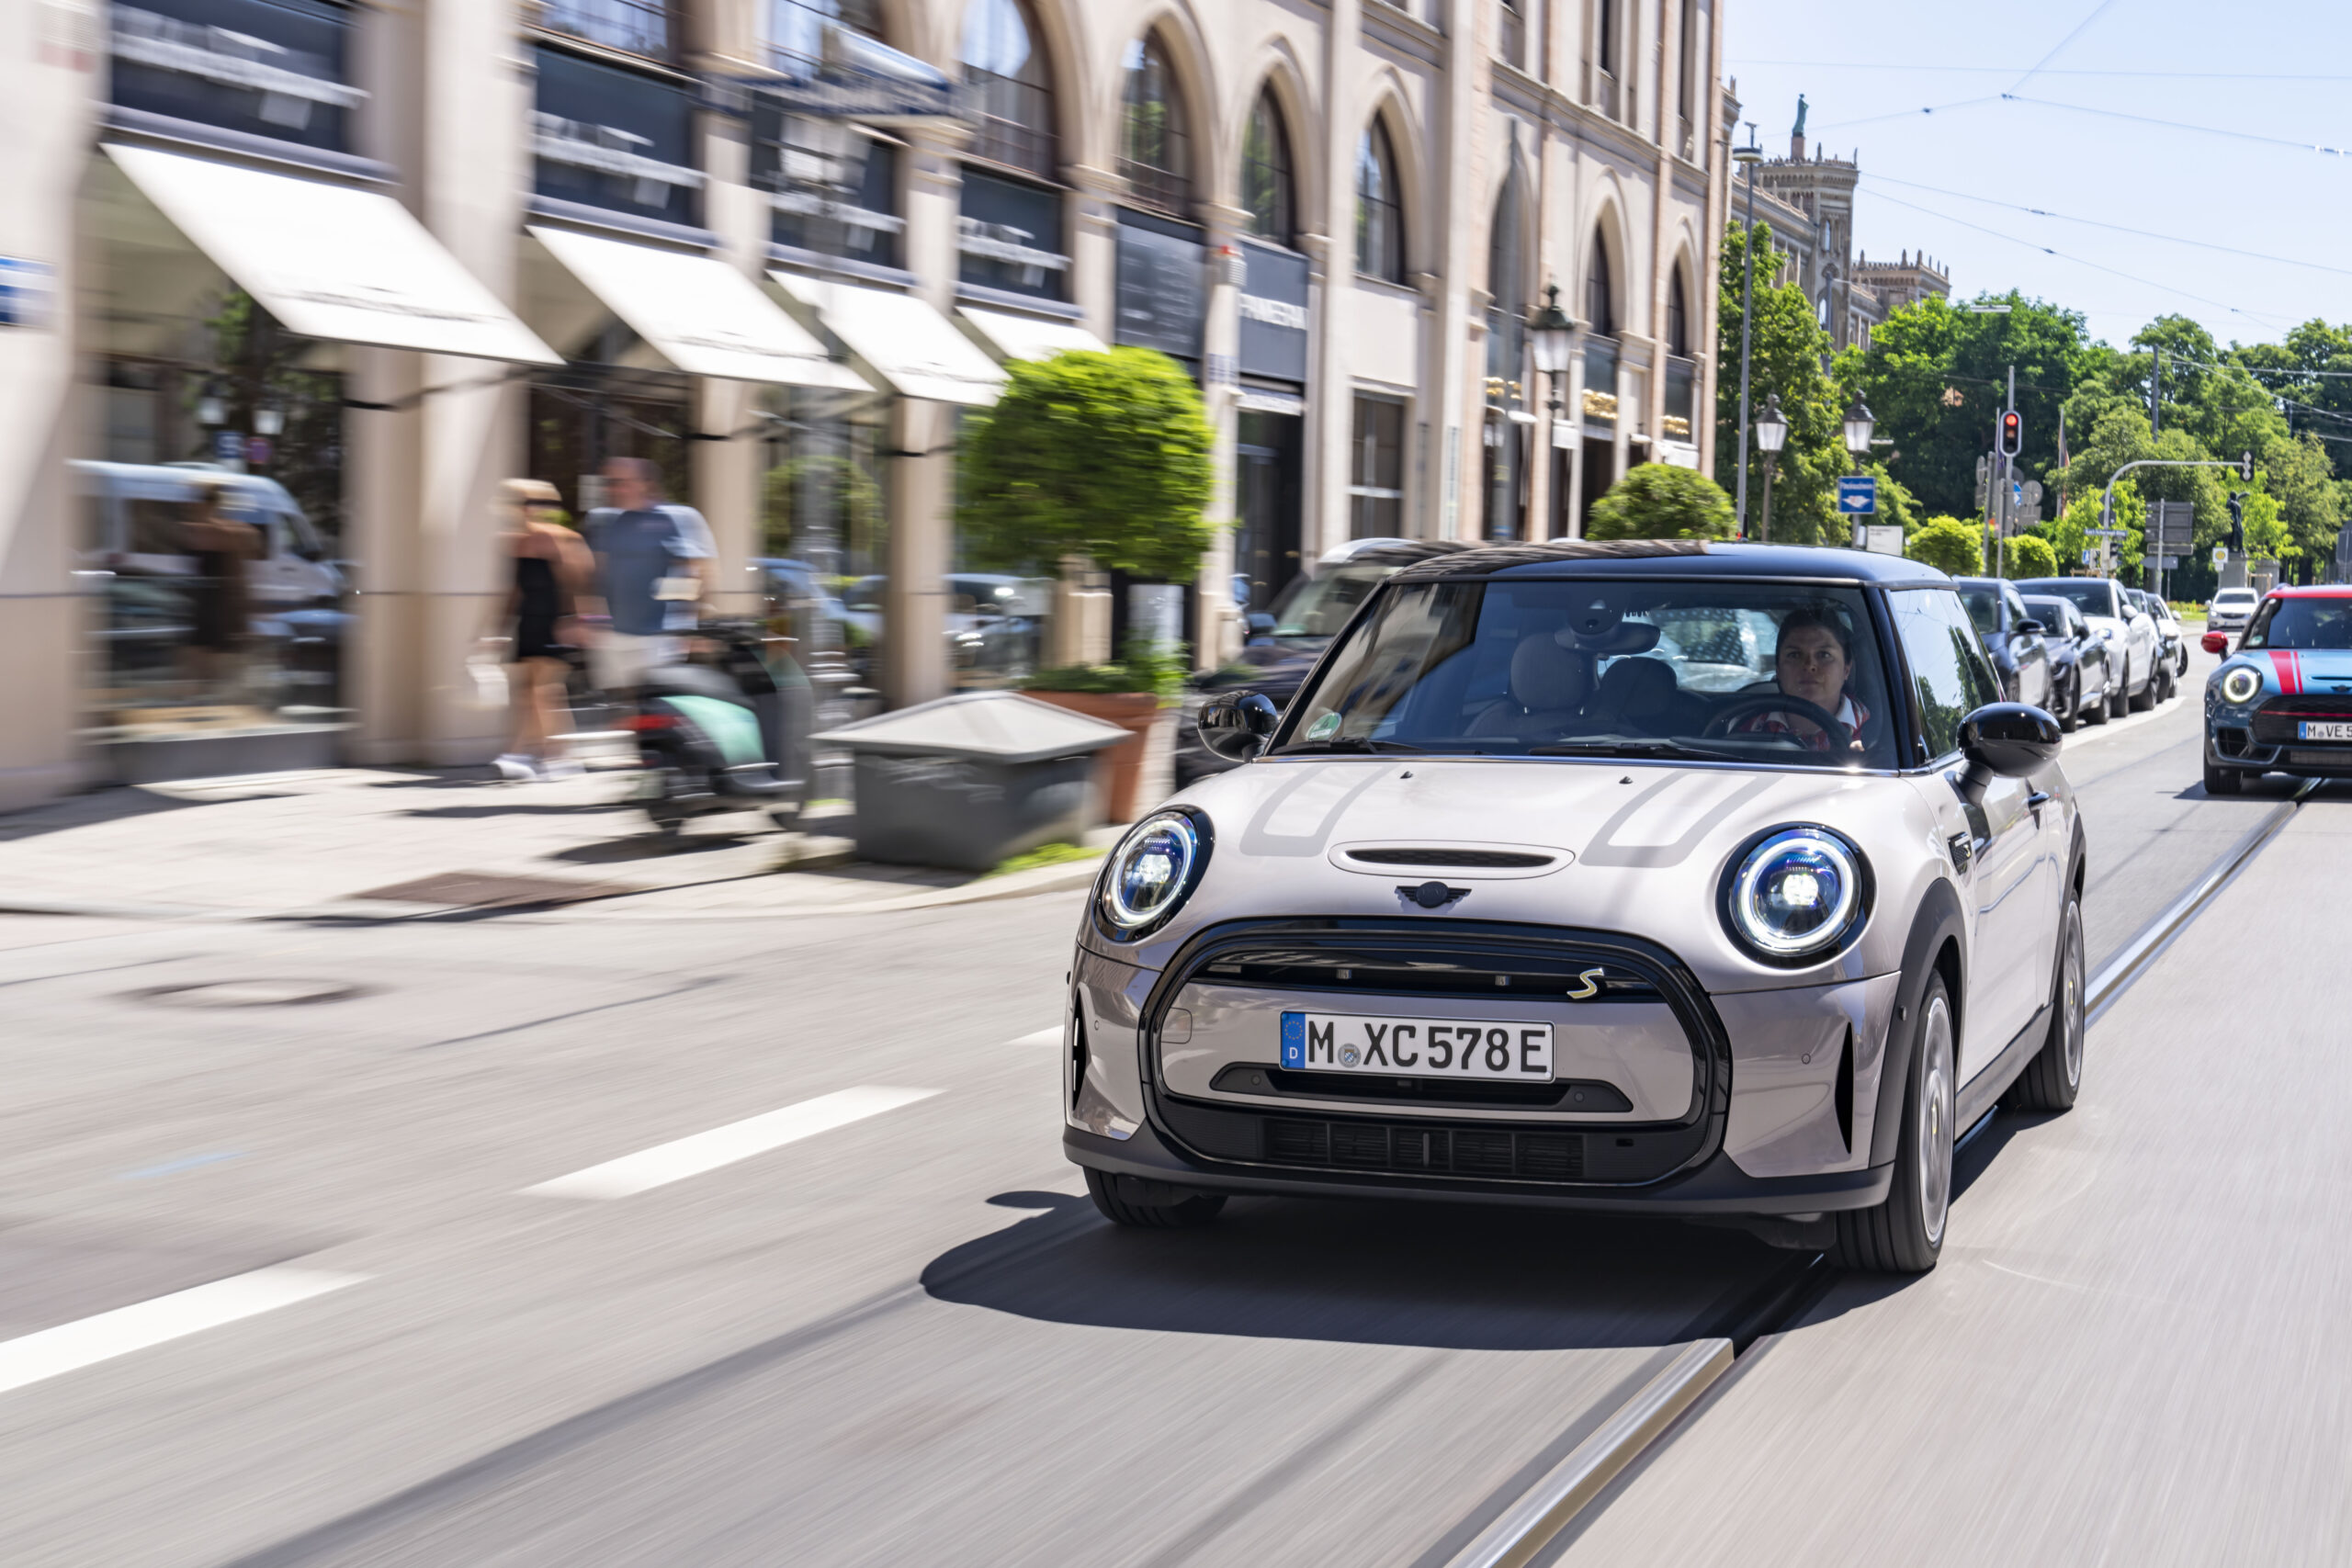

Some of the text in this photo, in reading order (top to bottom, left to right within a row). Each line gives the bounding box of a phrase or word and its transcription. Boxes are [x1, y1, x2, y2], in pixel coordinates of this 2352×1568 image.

[2307, 725, 2316, 737] M
[2326, 725, 2343, 738] VE
[1566, 967, 1604, 998] S
[1289, 1047, 1298, 1059] D
[1308, 1021, 1334, 1064] M
